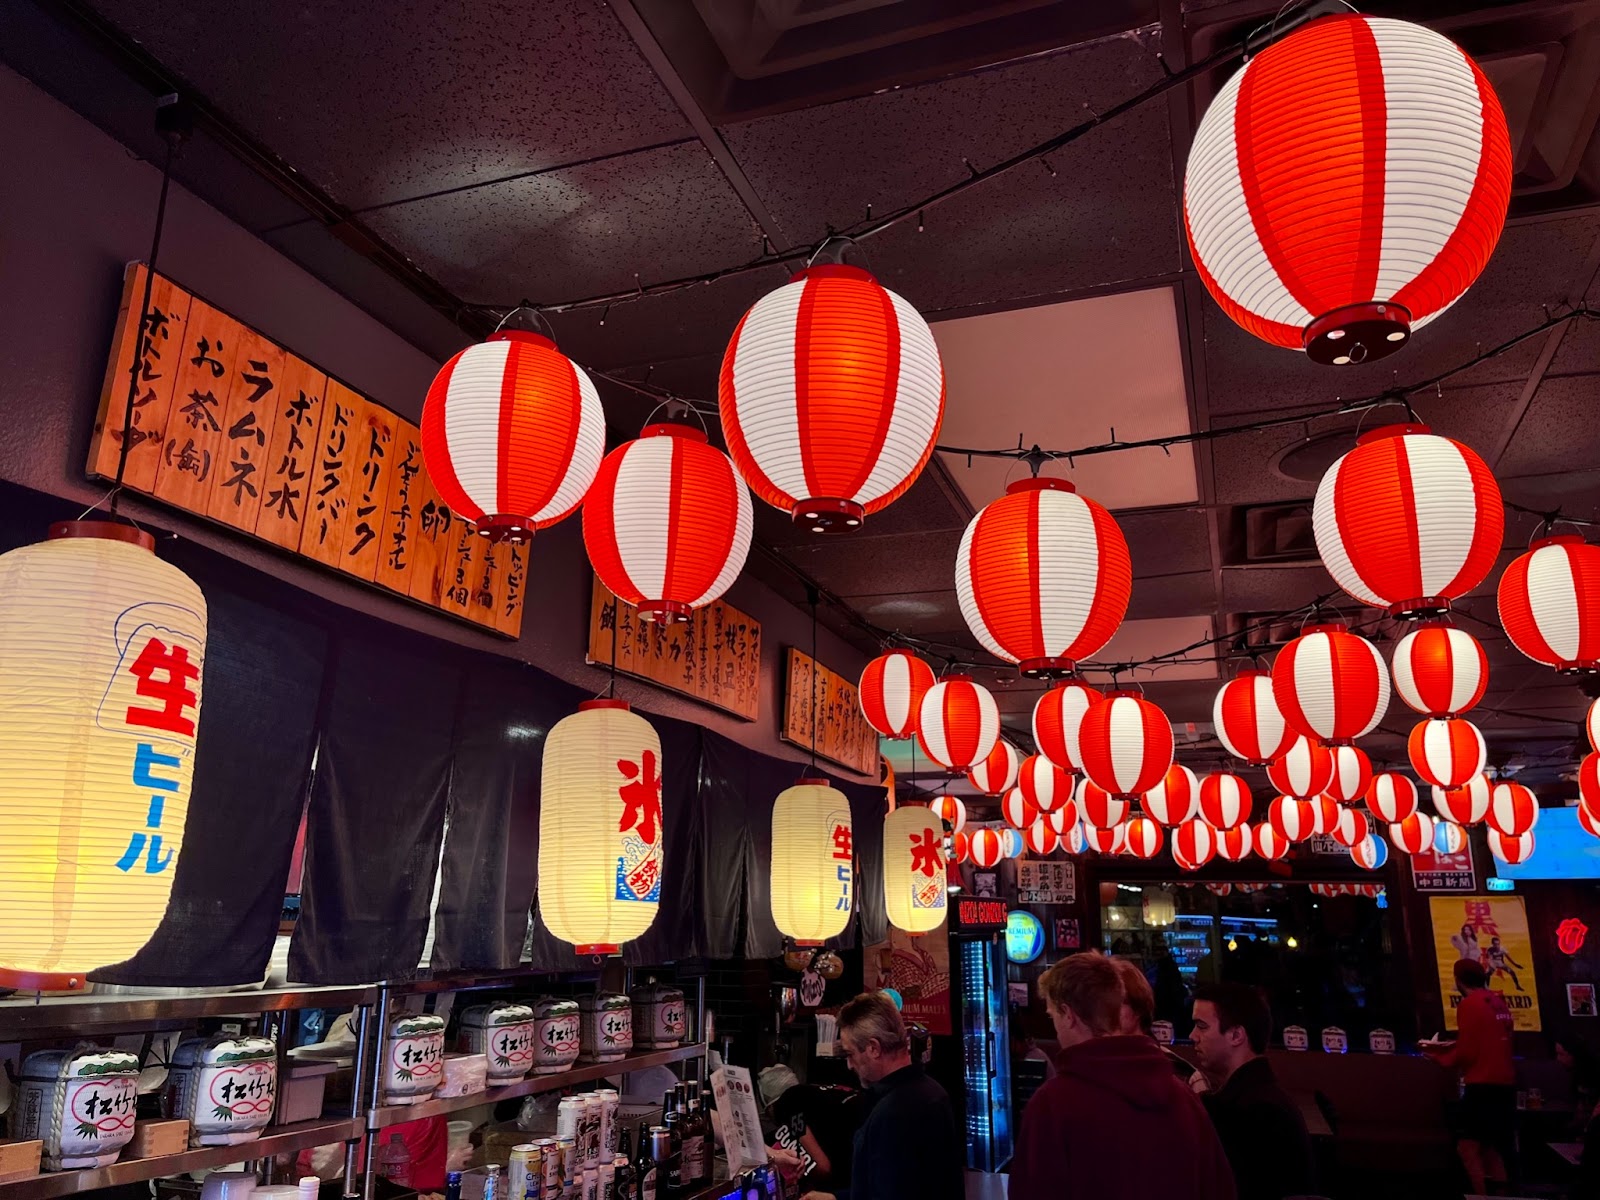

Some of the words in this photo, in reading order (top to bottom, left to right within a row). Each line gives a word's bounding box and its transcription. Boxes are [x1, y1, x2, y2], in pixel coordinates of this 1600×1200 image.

[221, 360, 274, 507] ラムネ
[265, 390, 319, 522] ボトル水
[316, 401, 354, 545] ドリンクバー
[348, 425, 391, 556] ドリンク
[420, 499, 452, 544] 卵
[908, 828, 943, 877] 氷
